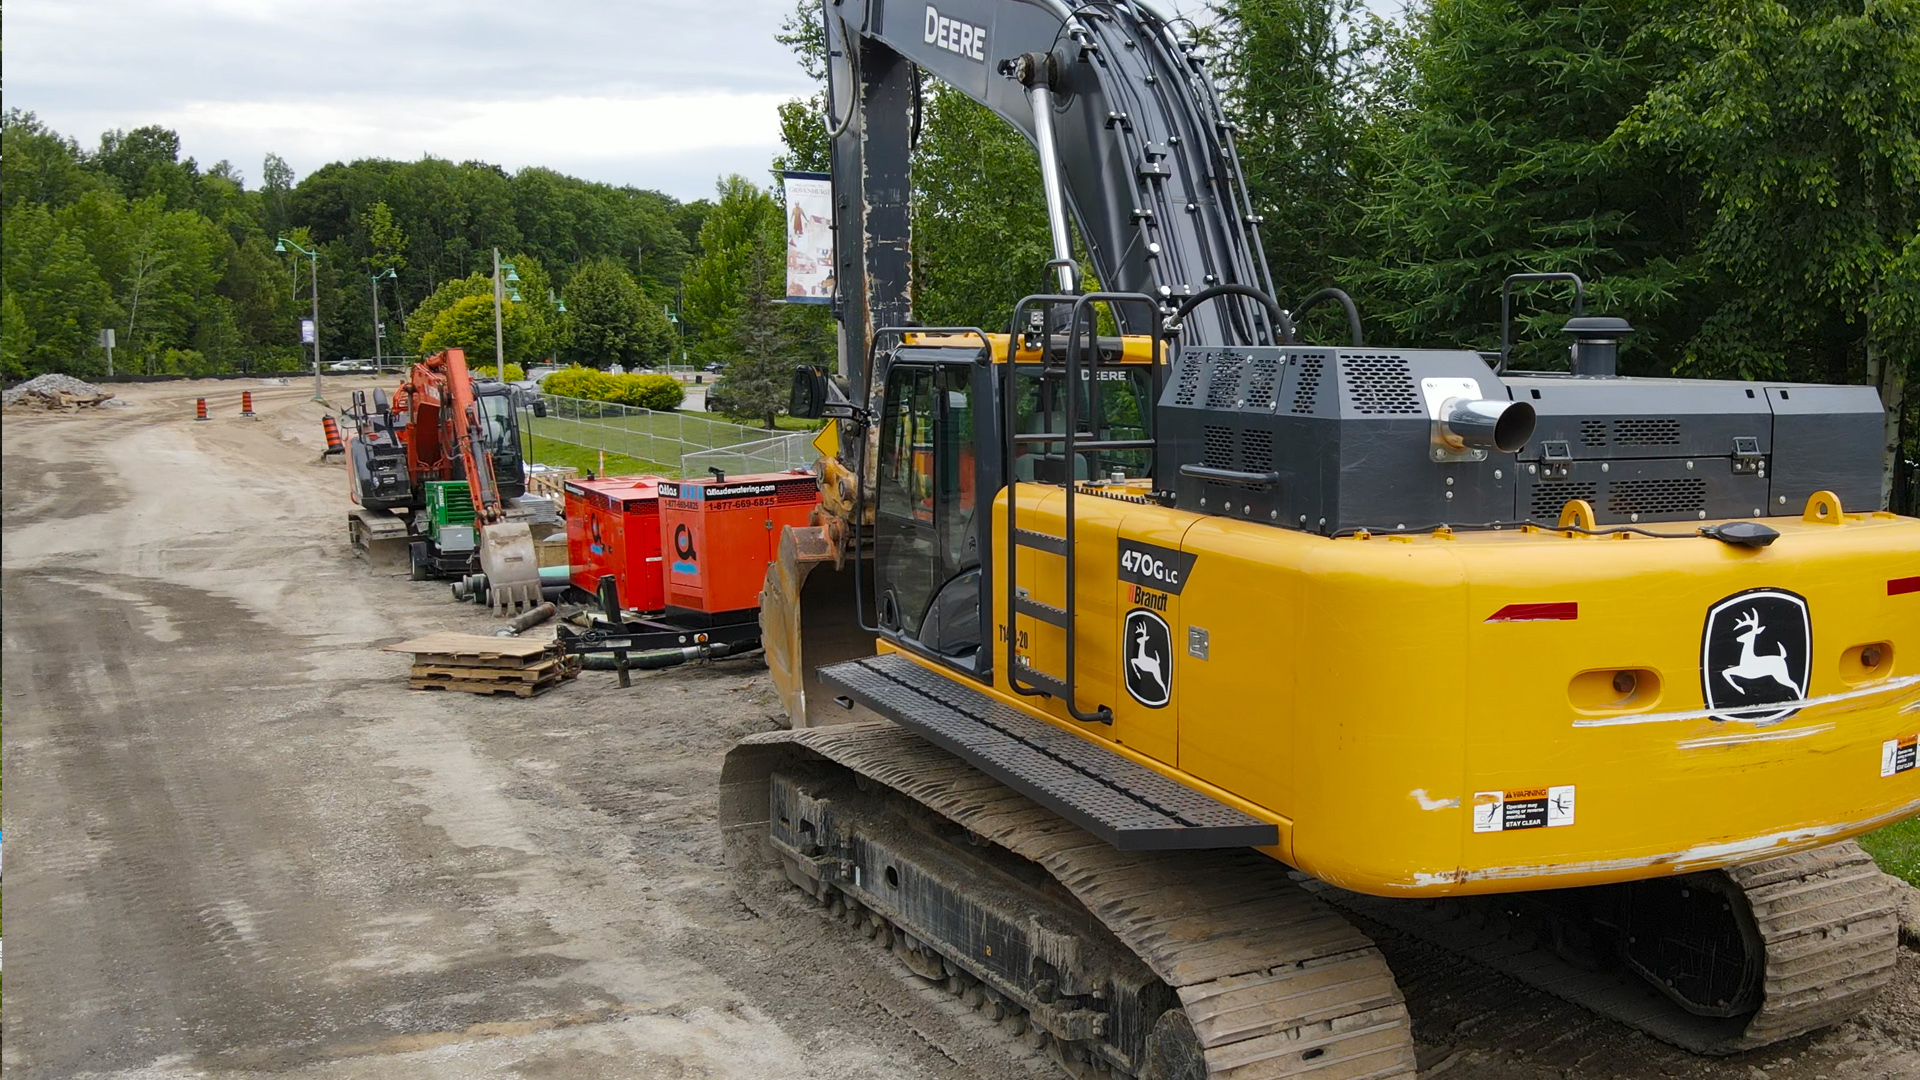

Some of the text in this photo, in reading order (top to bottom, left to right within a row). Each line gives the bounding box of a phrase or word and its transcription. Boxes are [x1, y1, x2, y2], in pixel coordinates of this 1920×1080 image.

[924, 5, 986, 61] DEERE
[709, 498, 775, 511] 1-877-669-6825
[1121, 550, 1178, 584] 470G LC
[1133, 585, 1168, 613] Brandt
[1513, 788, 1547, 798] WARNING
[1521, 818, 1541, 826] CLEAR
